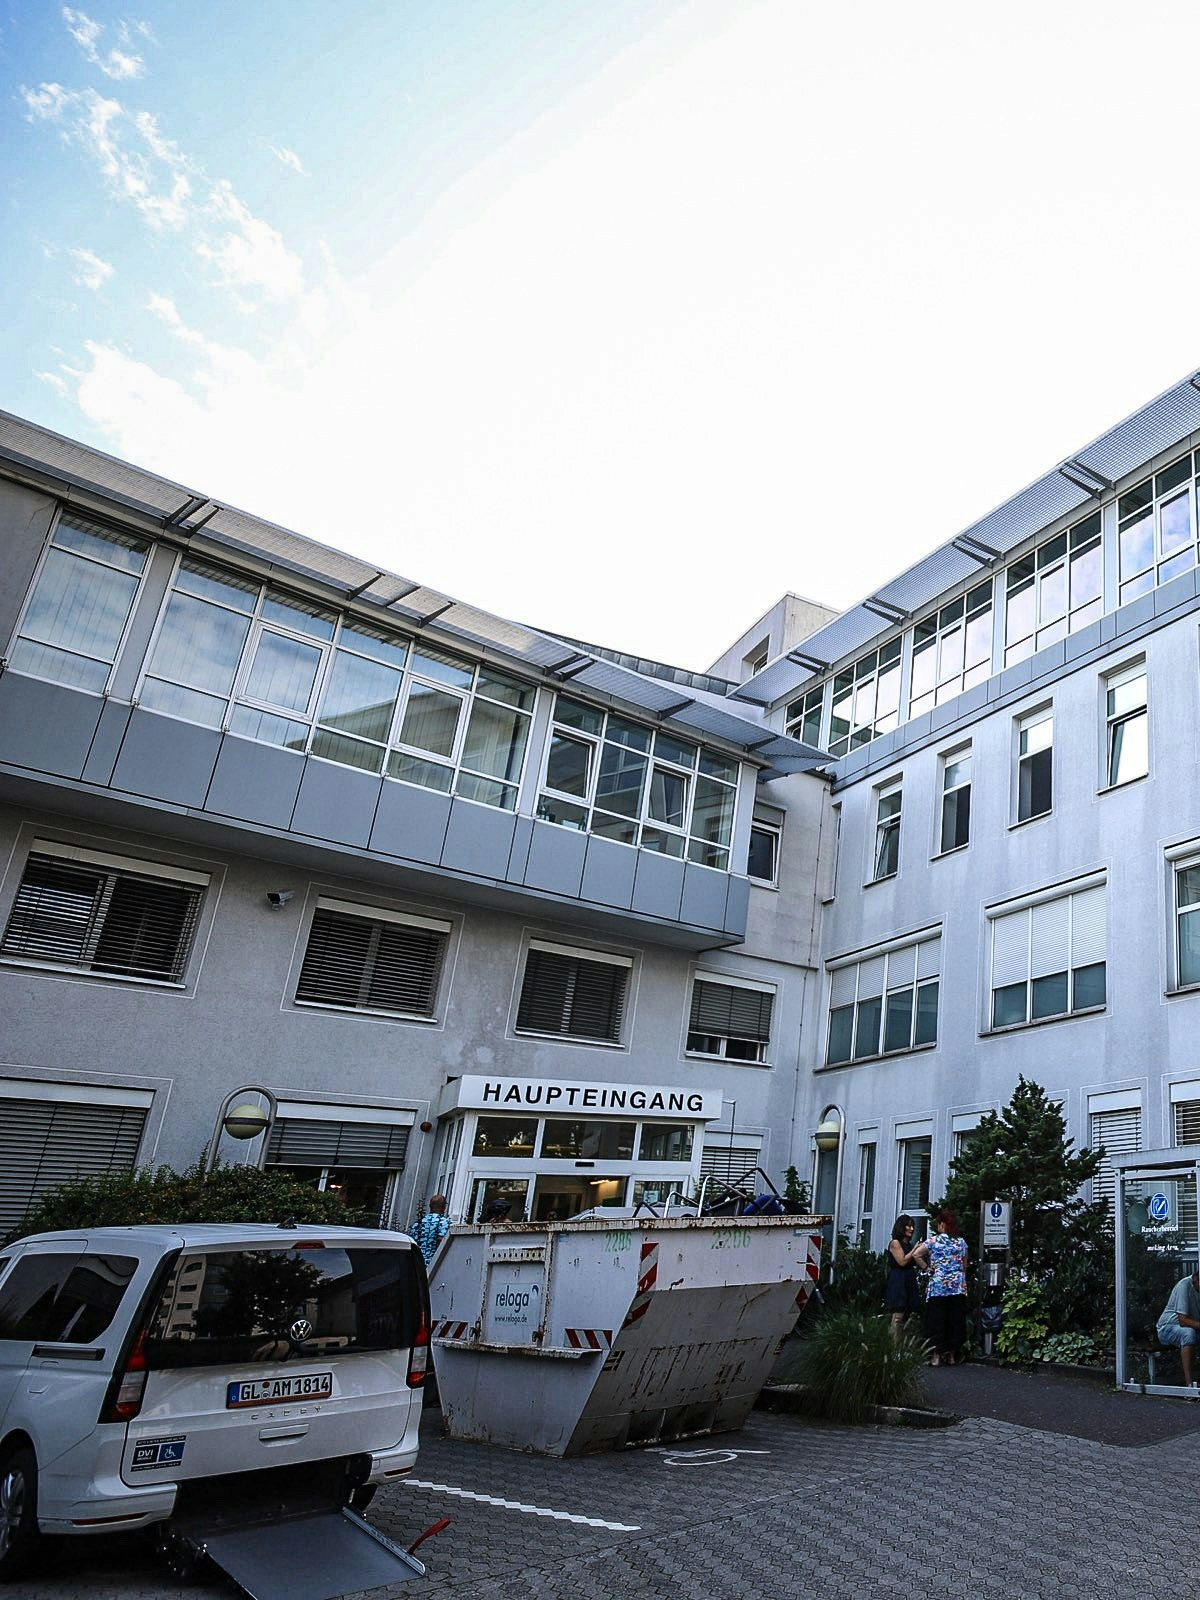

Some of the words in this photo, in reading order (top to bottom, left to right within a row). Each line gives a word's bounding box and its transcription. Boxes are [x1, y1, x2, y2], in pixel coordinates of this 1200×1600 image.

[483, 1083, 703, 1112] HAUPTEINGANG
[495, 1285, 530, 1313] reloga
[495, 1314, 528, 1325] www.reloga.de
[241, 1384, 260, 1401] GL
[294, 1376, 330, 1395] 1814
